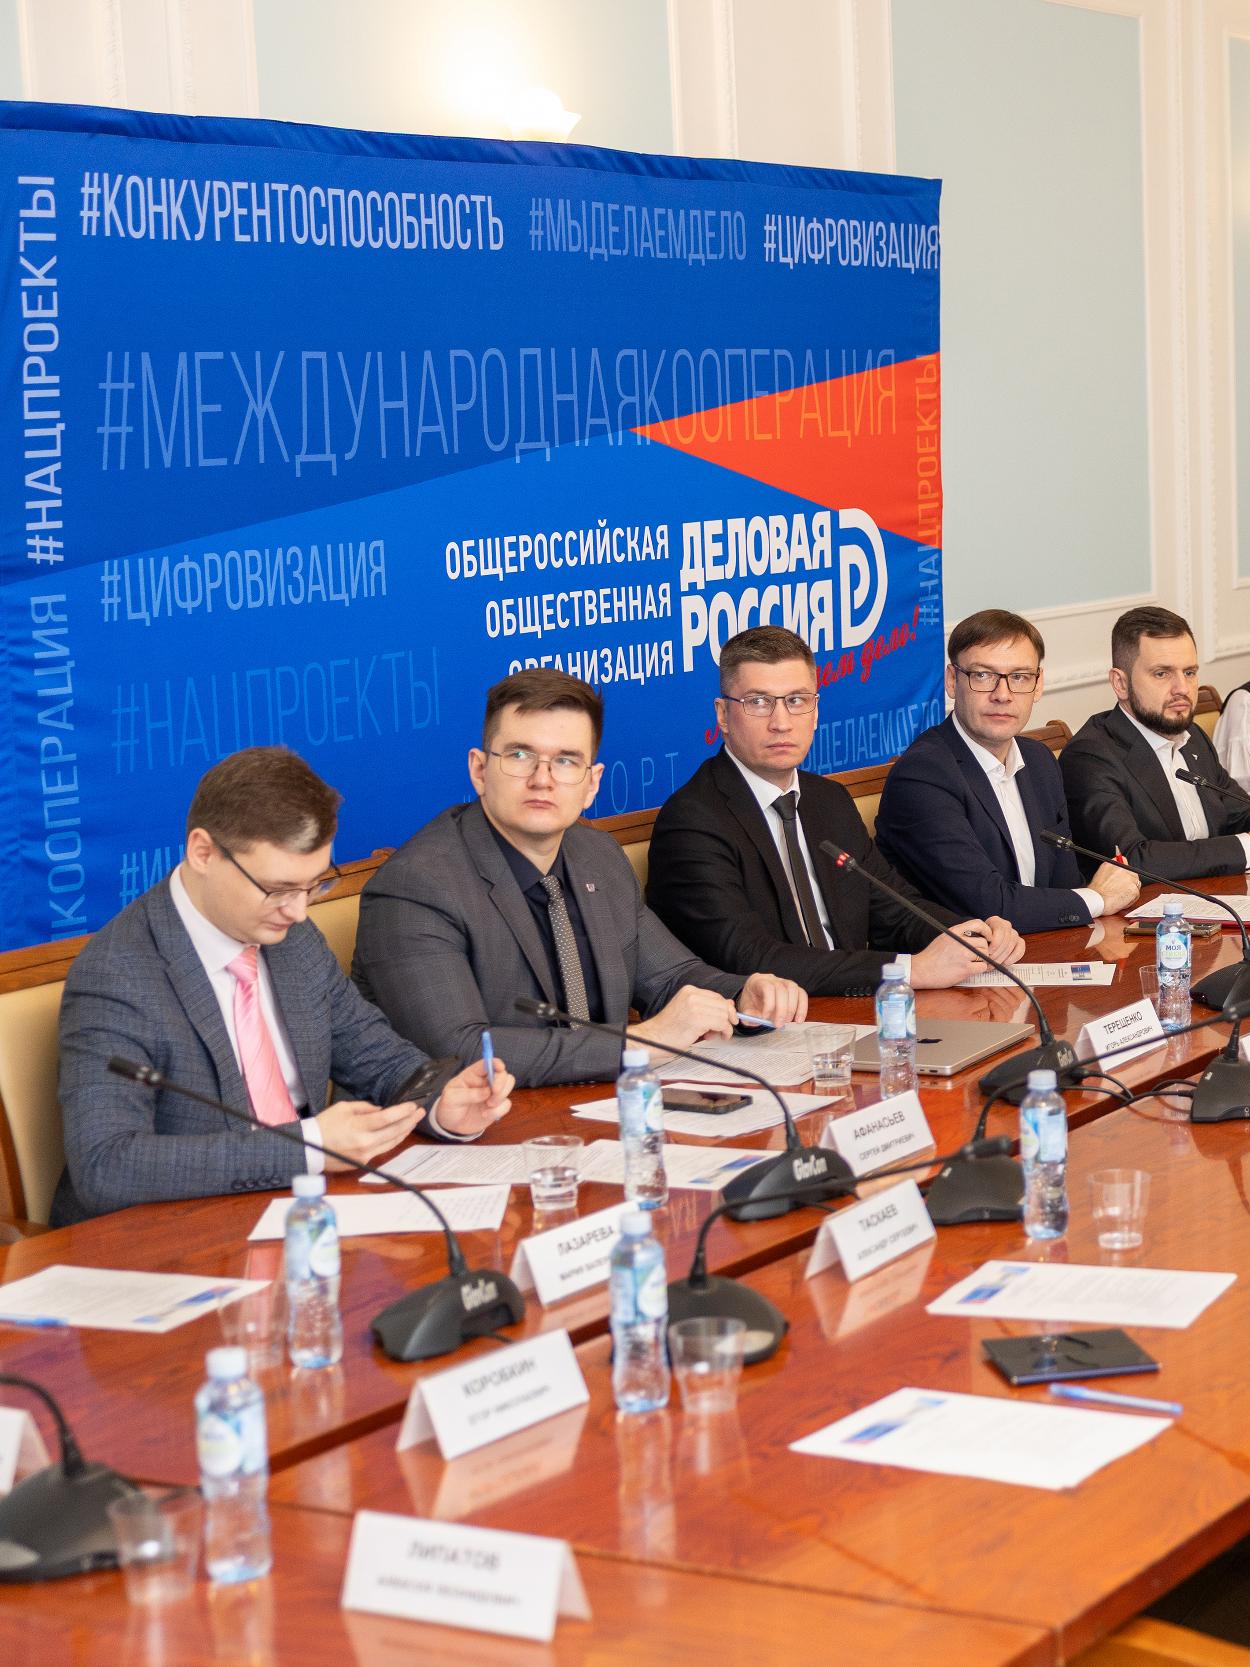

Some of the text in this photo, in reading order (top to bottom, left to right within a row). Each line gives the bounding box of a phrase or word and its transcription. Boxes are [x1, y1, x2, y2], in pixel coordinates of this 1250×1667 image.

[80, 172, 939, 274] #КОНКУРЕНТОСПОСОБНОСТЬ #МЫДЕЛАЕМДЕЛО #ЦИФРОВИЗАЦИЯ
[18, 175, 65, 566] #НАЦПРОЕКТЫ
[97, 346, 896, 477] #МЕЖДУНАРОДНАЯКООПЕРАЦИЯ
[916, 354, 940, 626] #НАЦПРОЕКТЫ
[100, 540, 388, 627] #ЦИФРОВИЗАЦИЯ
[445, 519, 670, 581] ОБЩЕРОССИЙСКАЯ
[680, 510, 832, 592] ДЕЛОВАЯ
[485, 582, 672, 639] ОБЩЕСТВЕННАЯ
[111, 646, 441, 775] #НАЦПРОЕКТЫ
[1103, 1011, 1143, 1035] ТЕРЕЩЕНКО
[1119, 1025, 1153, 1045] АЛЕКСАНДРОВИЧ
[853, 1110, 906, 1141] АФАНАСЬЕВ
[557, 1225, 615, 1256] ЛАЗАРЕВА
[858, 1203, 899, 1231] ТАСКАЕВ
